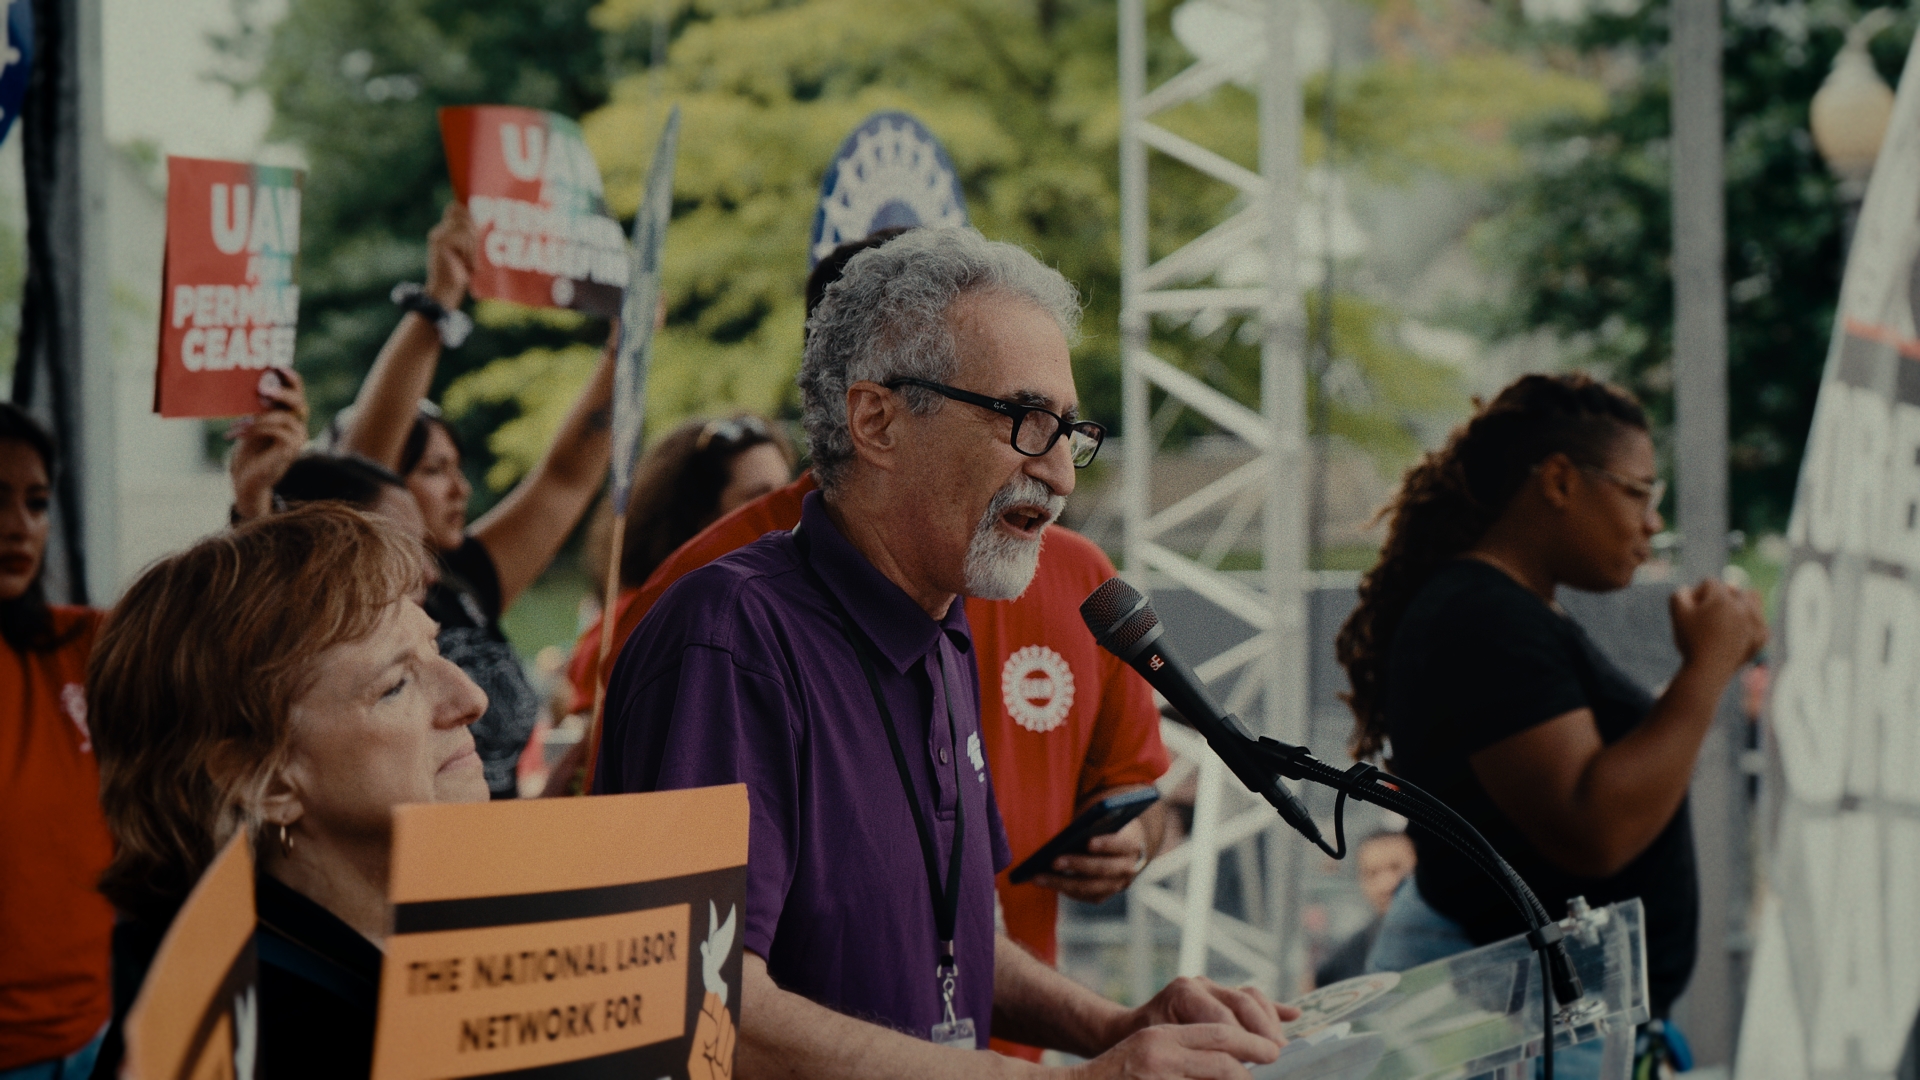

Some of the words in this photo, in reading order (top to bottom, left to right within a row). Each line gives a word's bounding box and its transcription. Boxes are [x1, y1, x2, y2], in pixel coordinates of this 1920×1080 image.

[180, 326, 297, 373] CEASE
[407, 957, 460, 996] THE
[471, 940, 609, 990] NATIONAL
[615, 929, 677, 972] LABOR
[457, 1001, 596, 1055] NETWORK
[602, 992, 644, 1033] FOR
